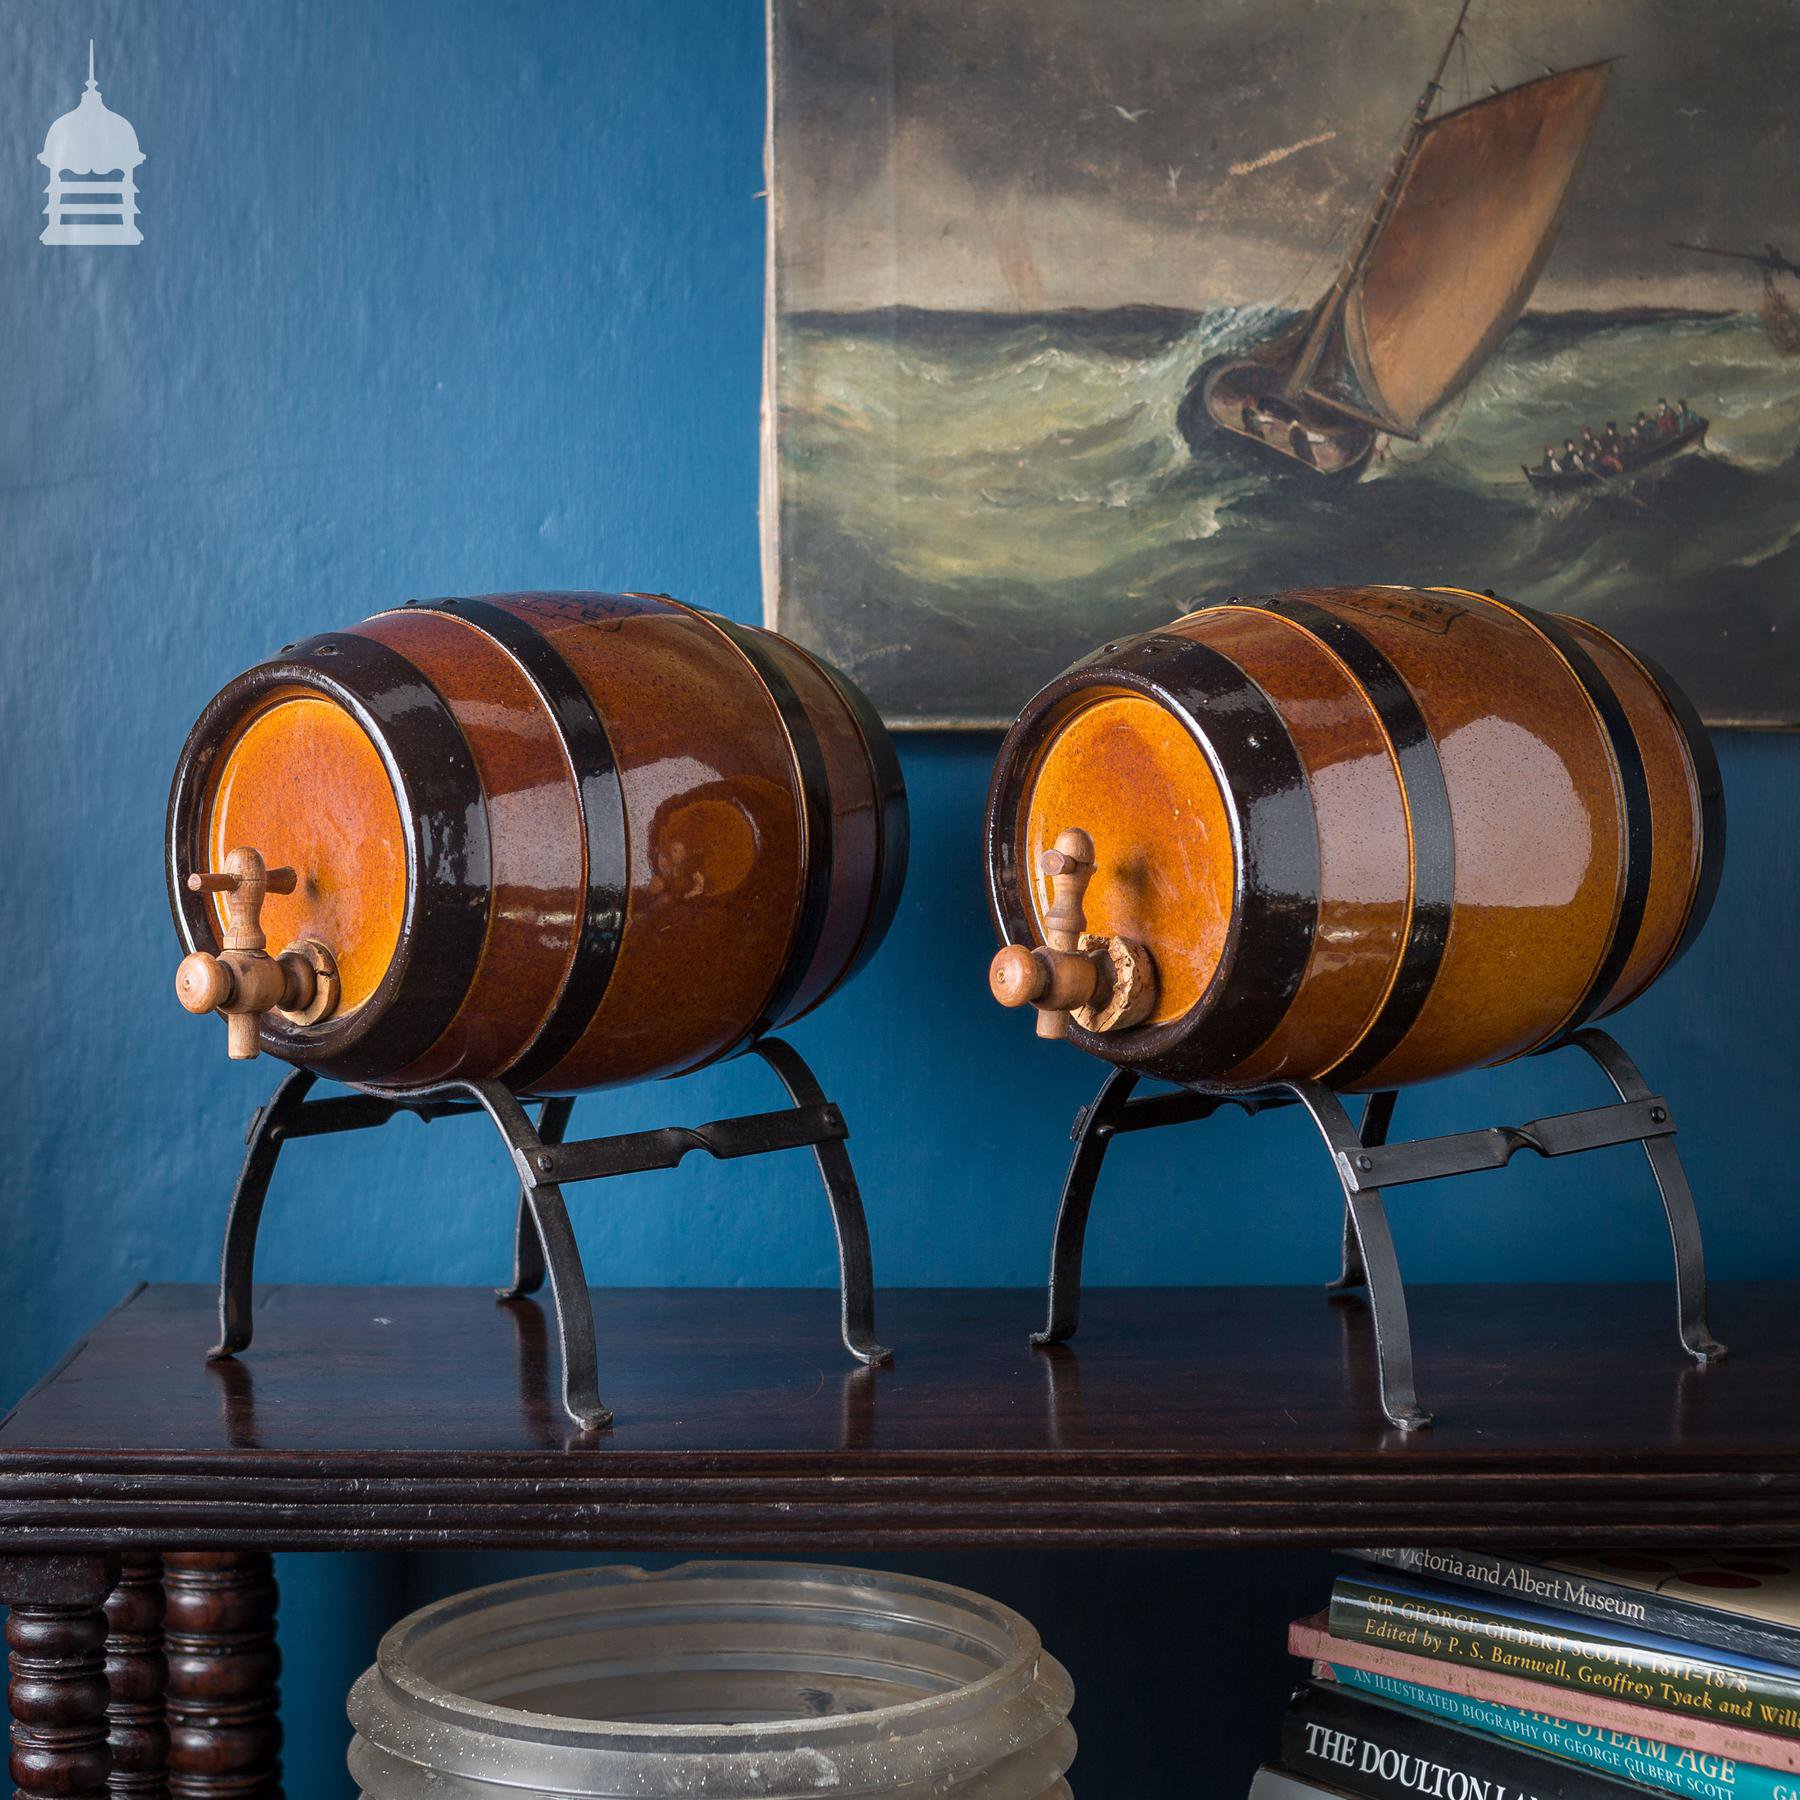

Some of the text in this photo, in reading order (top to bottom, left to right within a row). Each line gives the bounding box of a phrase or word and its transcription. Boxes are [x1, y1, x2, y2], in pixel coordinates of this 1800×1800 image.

[1400, 1548, 1463, 1575] Victoria
[1466, 1563, 1500, 1585] and
[1502, 1568, 1561, 1599] Albert
[1563, 1581, 1645, 1620] Museum
[1368, 1595, 1394, 1616] SIR
[1401, 1603, 1479, 1634] GEORGE
[1485, 1620, 1567, 1653] GILBERT
[1365, 1618, 1418, 1644] Edited
[1422, 1630, 1442, 1653] by
[1448, 1637, 1463, 1655] P.
[1470, 1642, 1484, 1659] S.
[1491, 1646, 1571, 1681] Barnwell,
[1578, 1665, 1653, 1699] Geoffrey
[1660, 1682, 1713, 1710] Tyack
[1718, 1700, 1753, 1718] and
[1305, 1722, 1492, 1800] THE DOULTON
[1354, 1669, 1371, 1684] AN
[1375, 1676, 1458, 1713] ILLUSTRATED
[1462, 1703, 1539, 1740] BIOGRAPHY
[1543, 1730, 1561, 1747] OF
[1564, 1738, 1621, 1767] GEORGE
[1624, 1758, 1683, 1786] GILBERT
[1686, 1776, 1735, 1800] SCOTT
[1676, 1749, 1736, 1784] AGE
